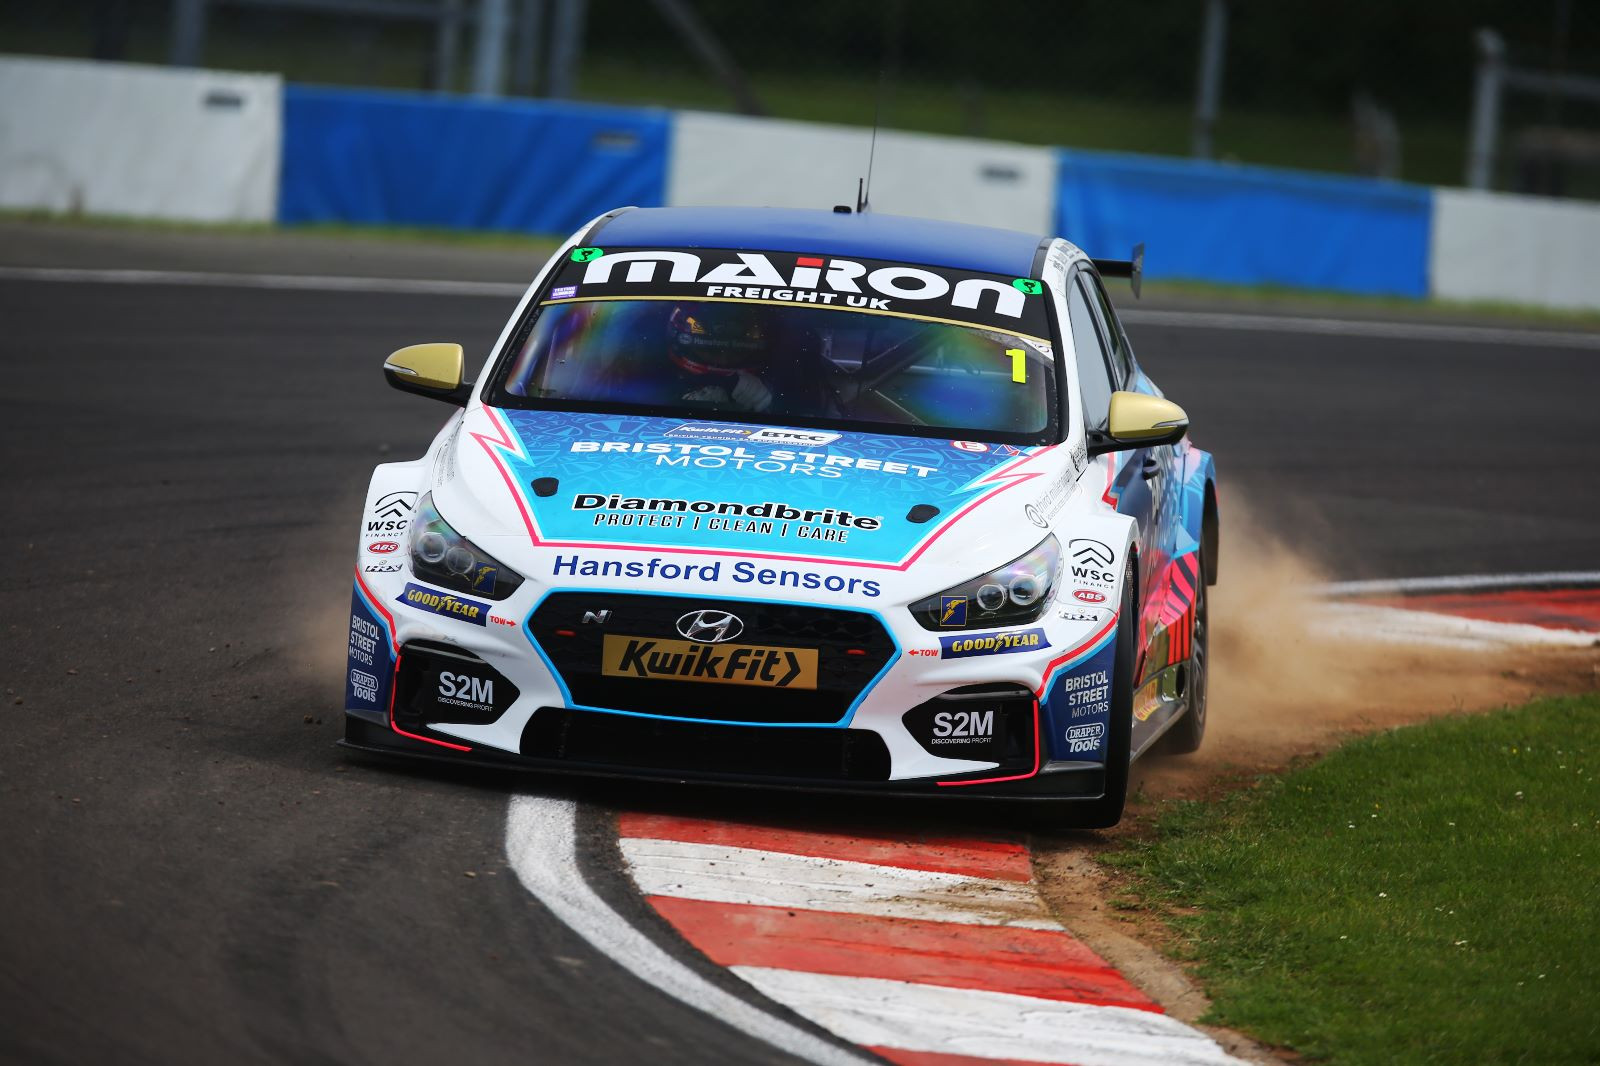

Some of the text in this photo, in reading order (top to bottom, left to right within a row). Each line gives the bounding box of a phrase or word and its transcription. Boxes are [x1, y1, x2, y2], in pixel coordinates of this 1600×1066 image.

[706, 285, 891, 311] FREIGHT UK
[1005, 348, 1027, 384] 1
[761, 431, 824, 442] BTCC
[570, 441, 938, 478] BRISTOL STREET
[655, 454, 842, 478] MOTORS
[572, 493, 881, 531] Diamondbrite
[367, 520, 408, 531] WSC
[593, 513, 849, 544] PROTECT CLEAN CARE
[372, 543, 397, 551] ABS
[552, 555, 882, 598] Hansford Sensors
[1071, 566, 1115, 583] WSC
[1073, 578, 1114, 590] FINANCE
[407, 588, 480, 618] GOODYEAR
[1077, 592, 1102, 600] ABS
[351, 614, 380, 641] BRISTOL
[489, 615, 506, 626] TOW
[350, 630, 377, 654] STREET
[952, 632, 1039, 653] GOODYEAR
[349, 645, 373, 666] MOTORS
[920, 649, 939, 657] TOW
[352, 671, 376, 688] DRAPER
[438, 671, 494, 705] S2M
[1065, 669, 1109, 692] BRISTOL
[437, 696, 494, 712] DISCOVERING PROFIT
[1068, 685, 1109, 706] STREET
[1071, 700, 1109, 719] MOTORS
[932, 710, 994, 737] S2M
[1069, 723, 1102, 739] DRAPER
[931, 736, 992, 745] DISCOVERING PROFIT
